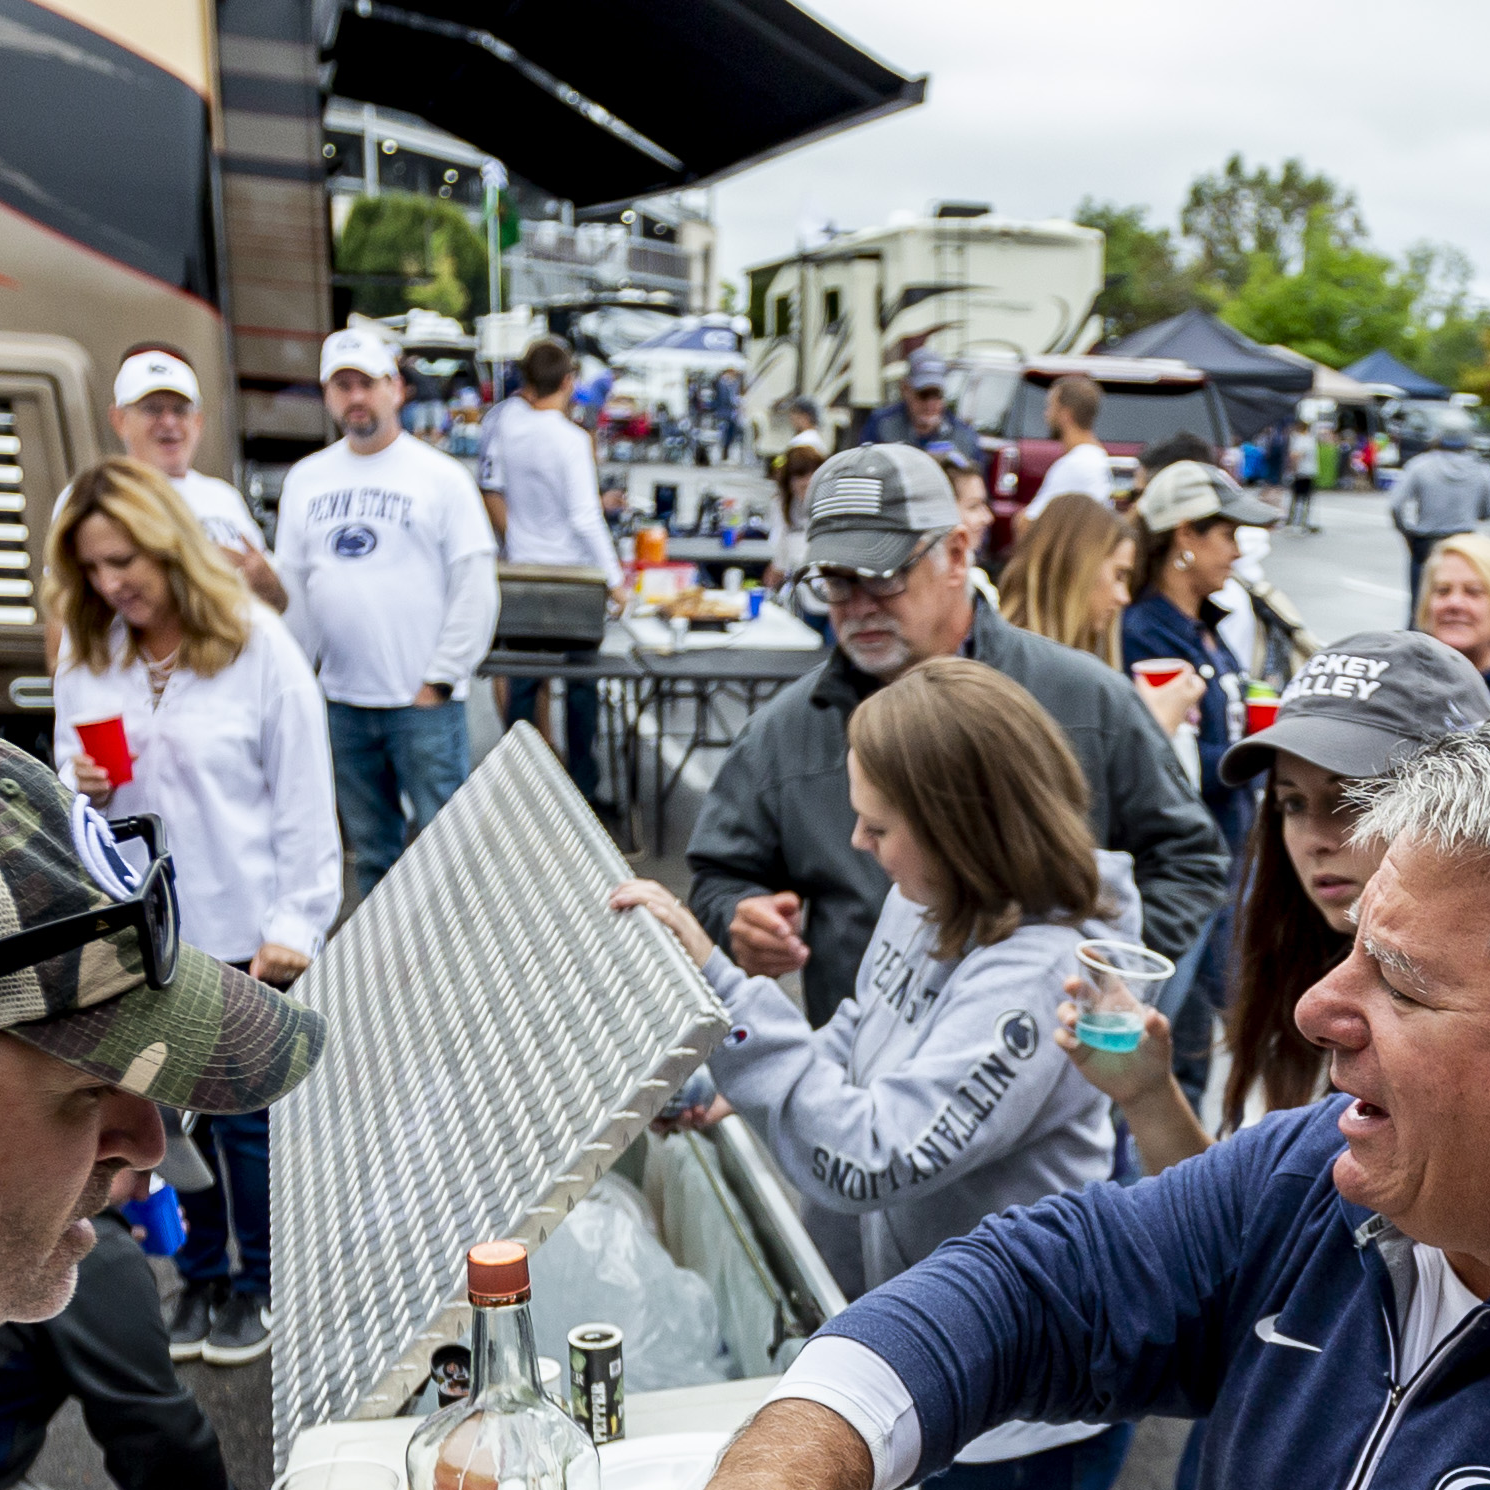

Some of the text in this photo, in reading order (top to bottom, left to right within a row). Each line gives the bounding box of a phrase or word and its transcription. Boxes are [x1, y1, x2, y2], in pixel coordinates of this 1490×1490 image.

[305, 487, 413, 529] PENN STATE
[813, 1053, 1017, 1201] NITTANY LIONS
[590, 1381, 608, 1443] PEPPER
